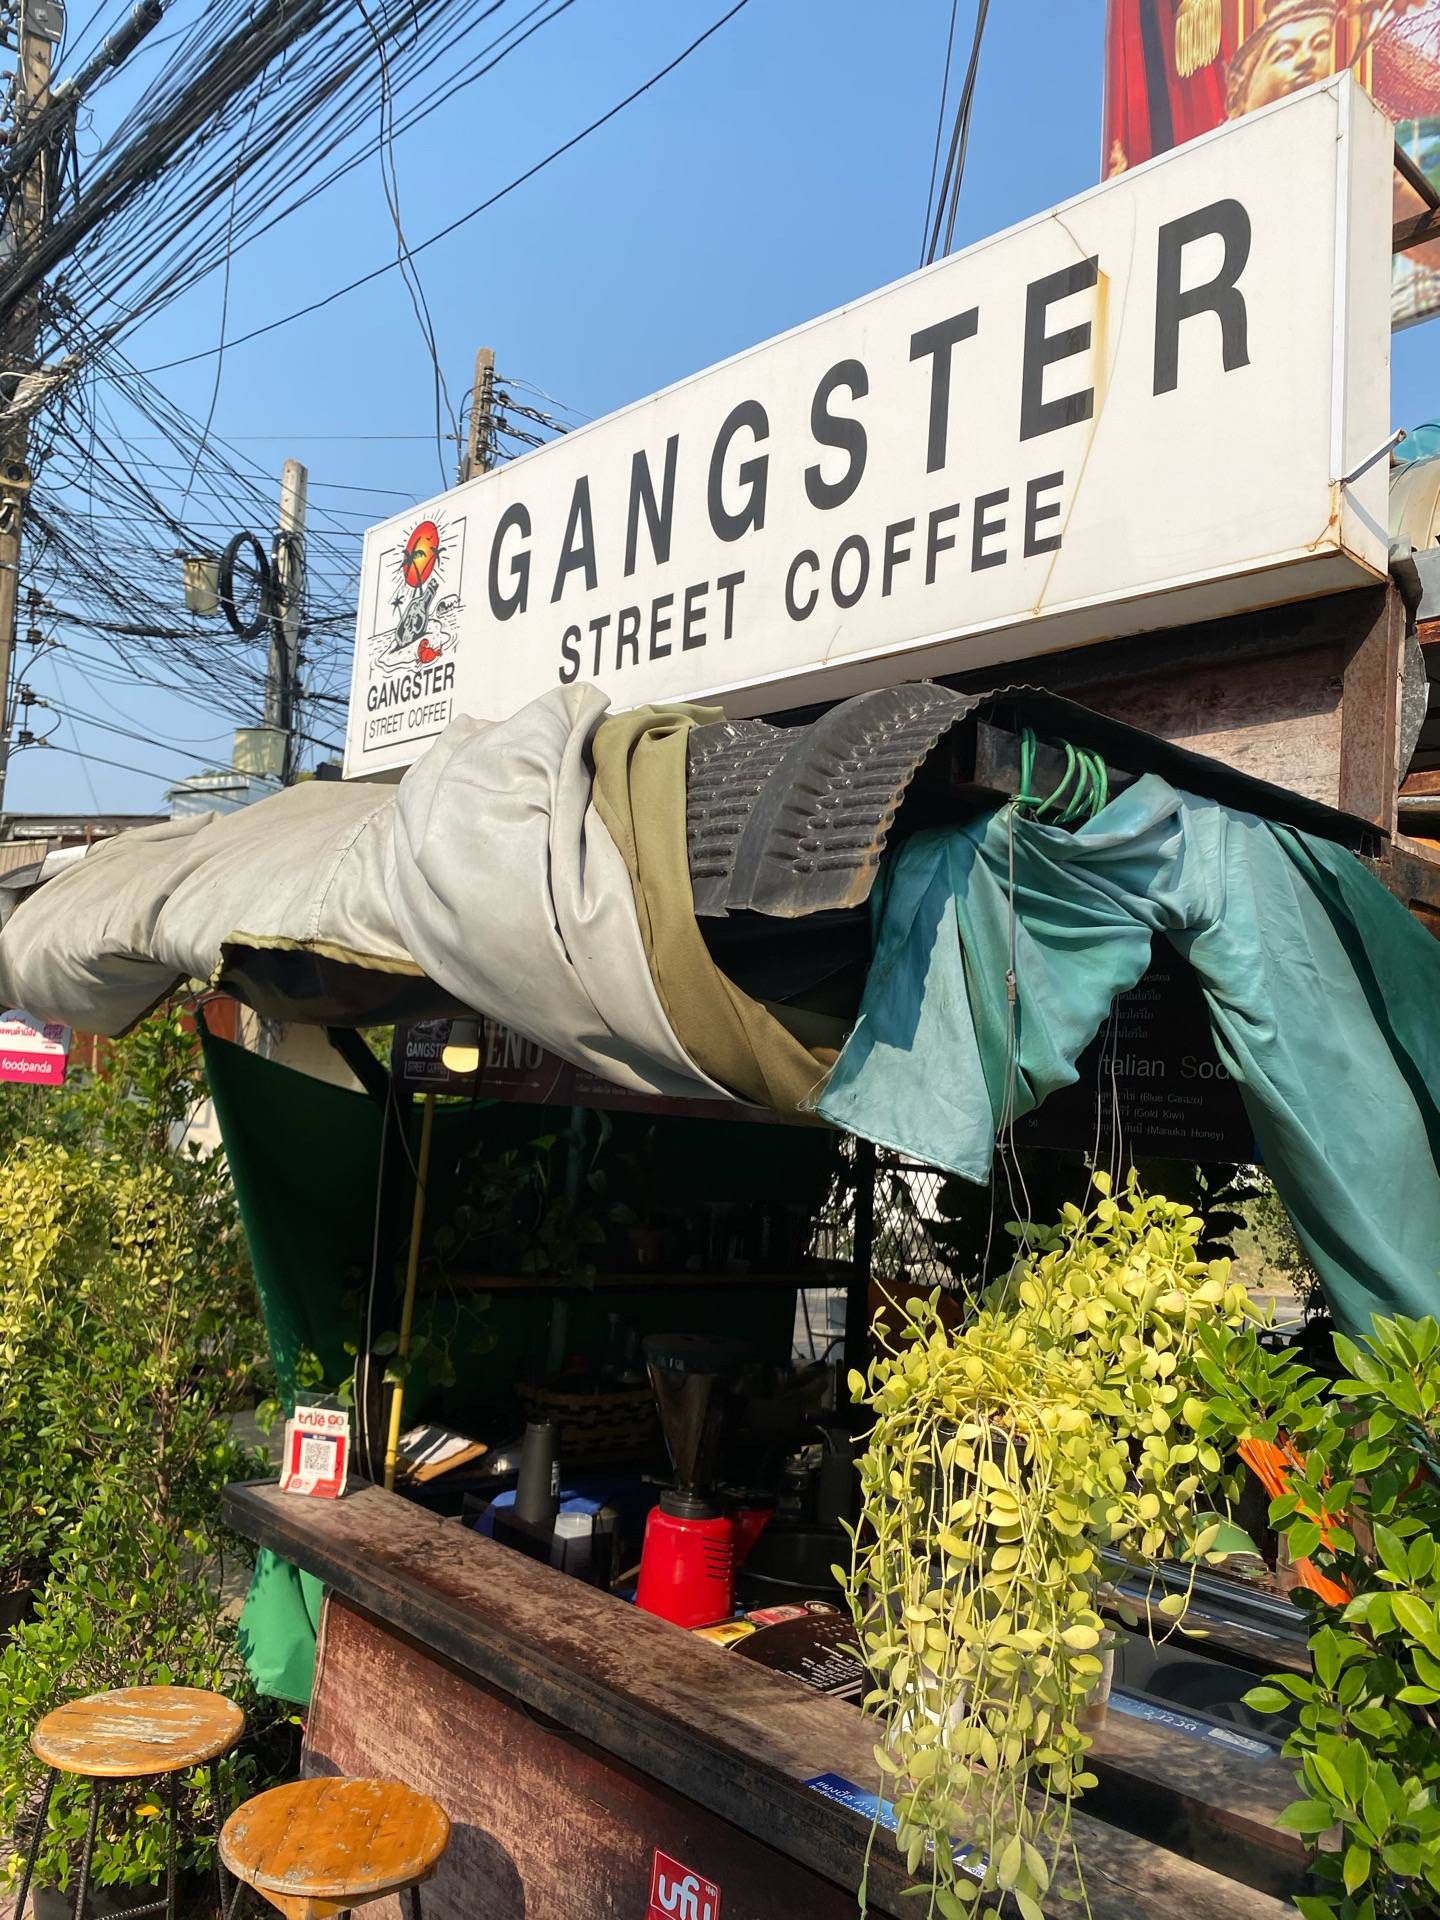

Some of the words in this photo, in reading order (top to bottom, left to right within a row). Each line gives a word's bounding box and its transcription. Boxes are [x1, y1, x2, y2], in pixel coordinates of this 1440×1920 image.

[487, 198, 1252, 622] GANGSTER
[558, 570, 746, 685] STREET
[785, 471, 1066, 622] COFFEE
[367, 662, 455, 712] GANGSTER
[369, 712, 404, 738] STREET
[408, 700, 447, 728] COFFEE
[2, 1058, 52, 1075] foodpanda
[406, 1042, 444, 1058] GANGST
[298, 1410, 325, 1426] true
